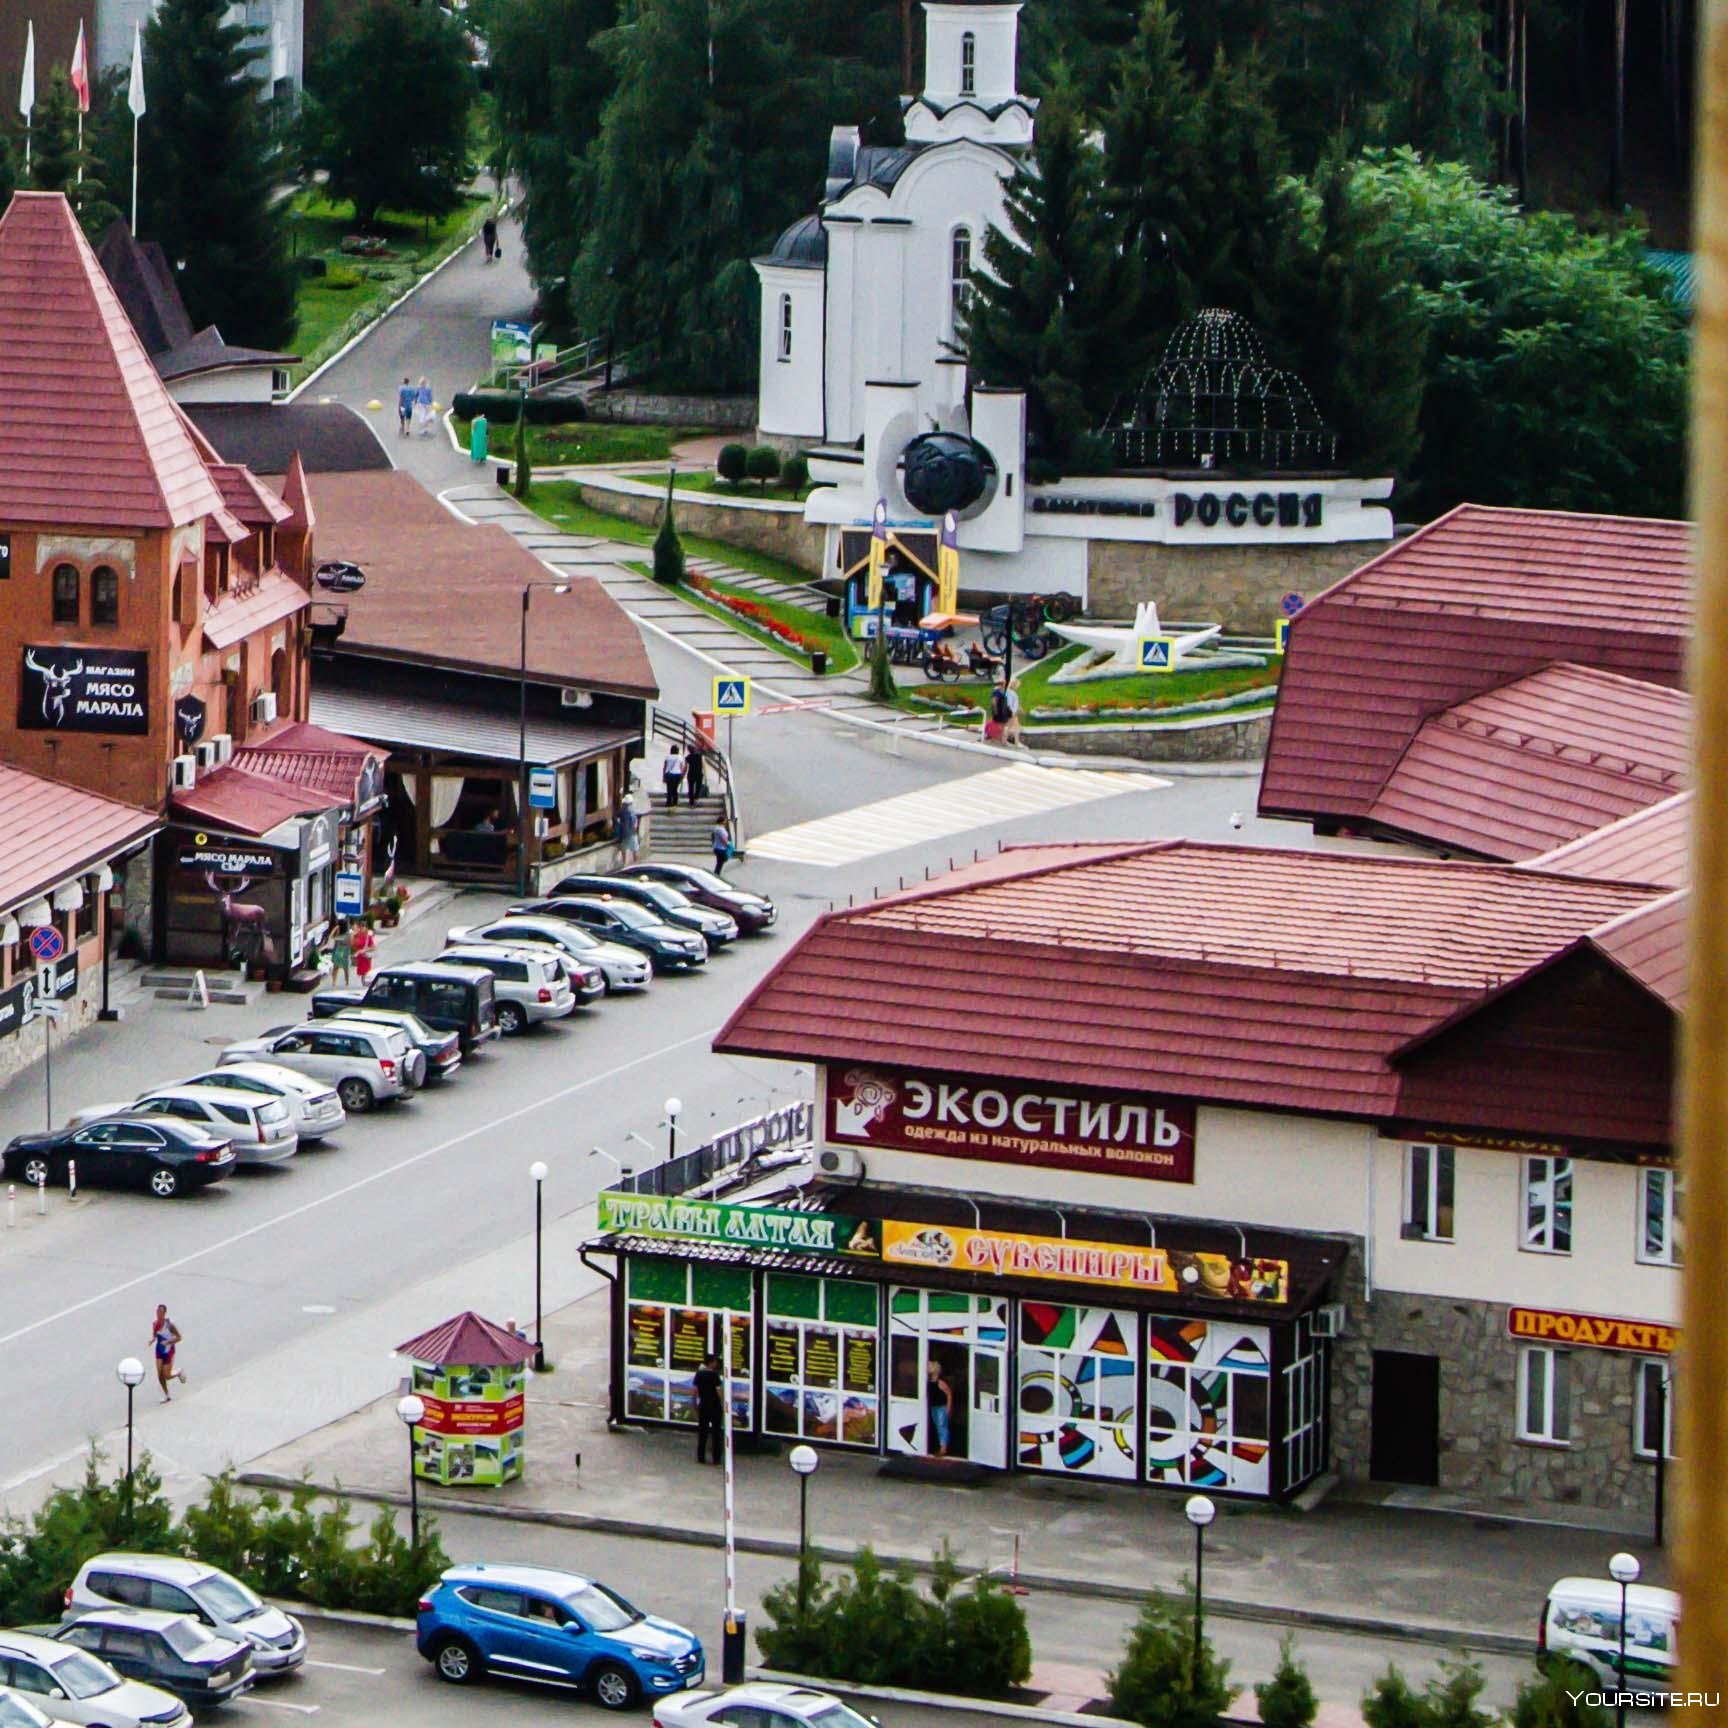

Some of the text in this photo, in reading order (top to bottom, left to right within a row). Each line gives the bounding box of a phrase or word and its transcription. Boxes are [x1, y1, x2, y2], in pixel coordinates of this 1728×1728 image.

[1173, 492, 1323, 528] РОССИЯ
[85, 665, 135, 677] МАГАЗИН
[76, 699, 144, 717] МАРАЛА
[85, 682, 135, 698] МЯСО
[194, 851, 273, 866] МЯСО МАРАЛА
[902, 1080, 1182, 1148] ЭКОСТИЛЬ
[904, 1124, 1176, 1167] одежда из натуральных волокон
[606, 1198, 836, 1249] ТРАВЫ АЛТАЯ
[964, 1235, 1168, 1286] СУВЕНИРЫ
